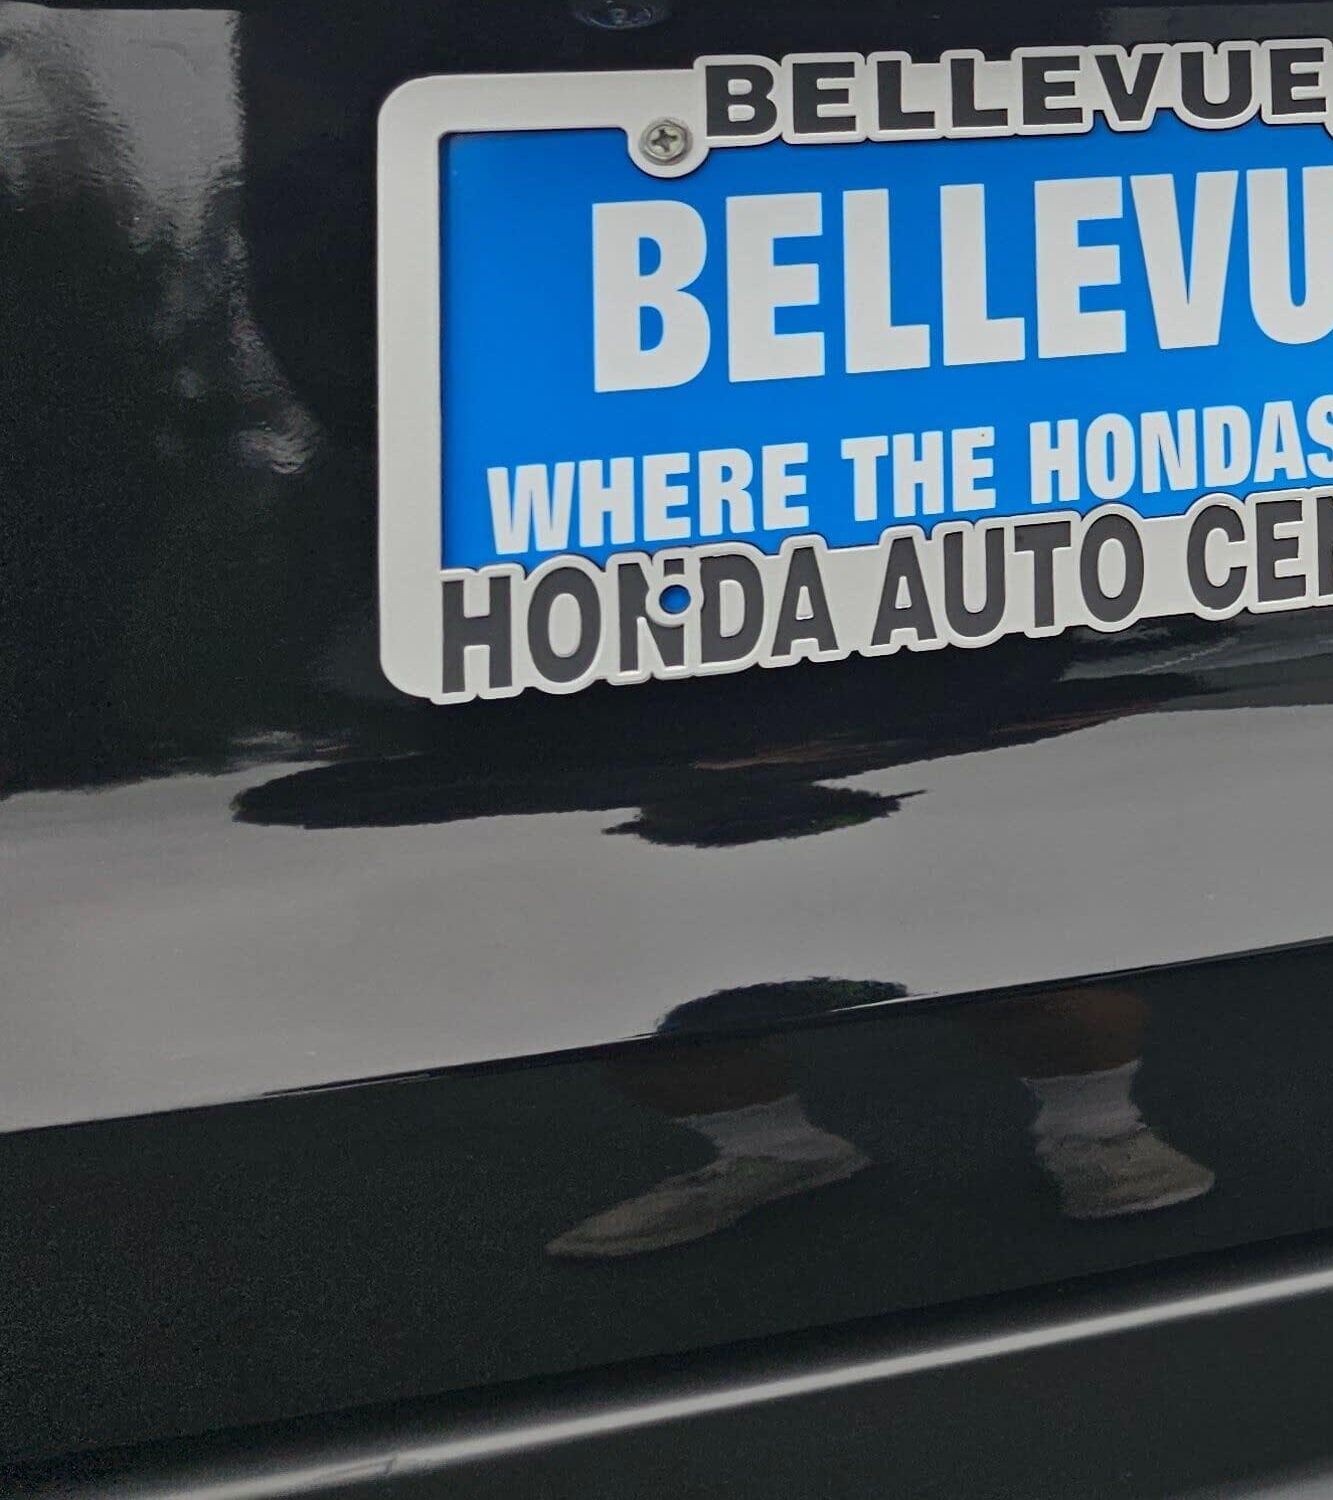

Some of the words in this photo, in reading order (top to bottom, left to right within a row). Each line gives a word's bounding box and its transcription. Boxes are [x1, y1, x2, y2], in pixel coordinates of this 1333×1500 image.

[705, 46, 1327, 138] BELLEVUE
[486, 443, 808, 555] WHERE
[841, 430, 996, 522] THE
[440, 551, 841, 693] HONDA
[871, 507, 1146, 648] AUTO
